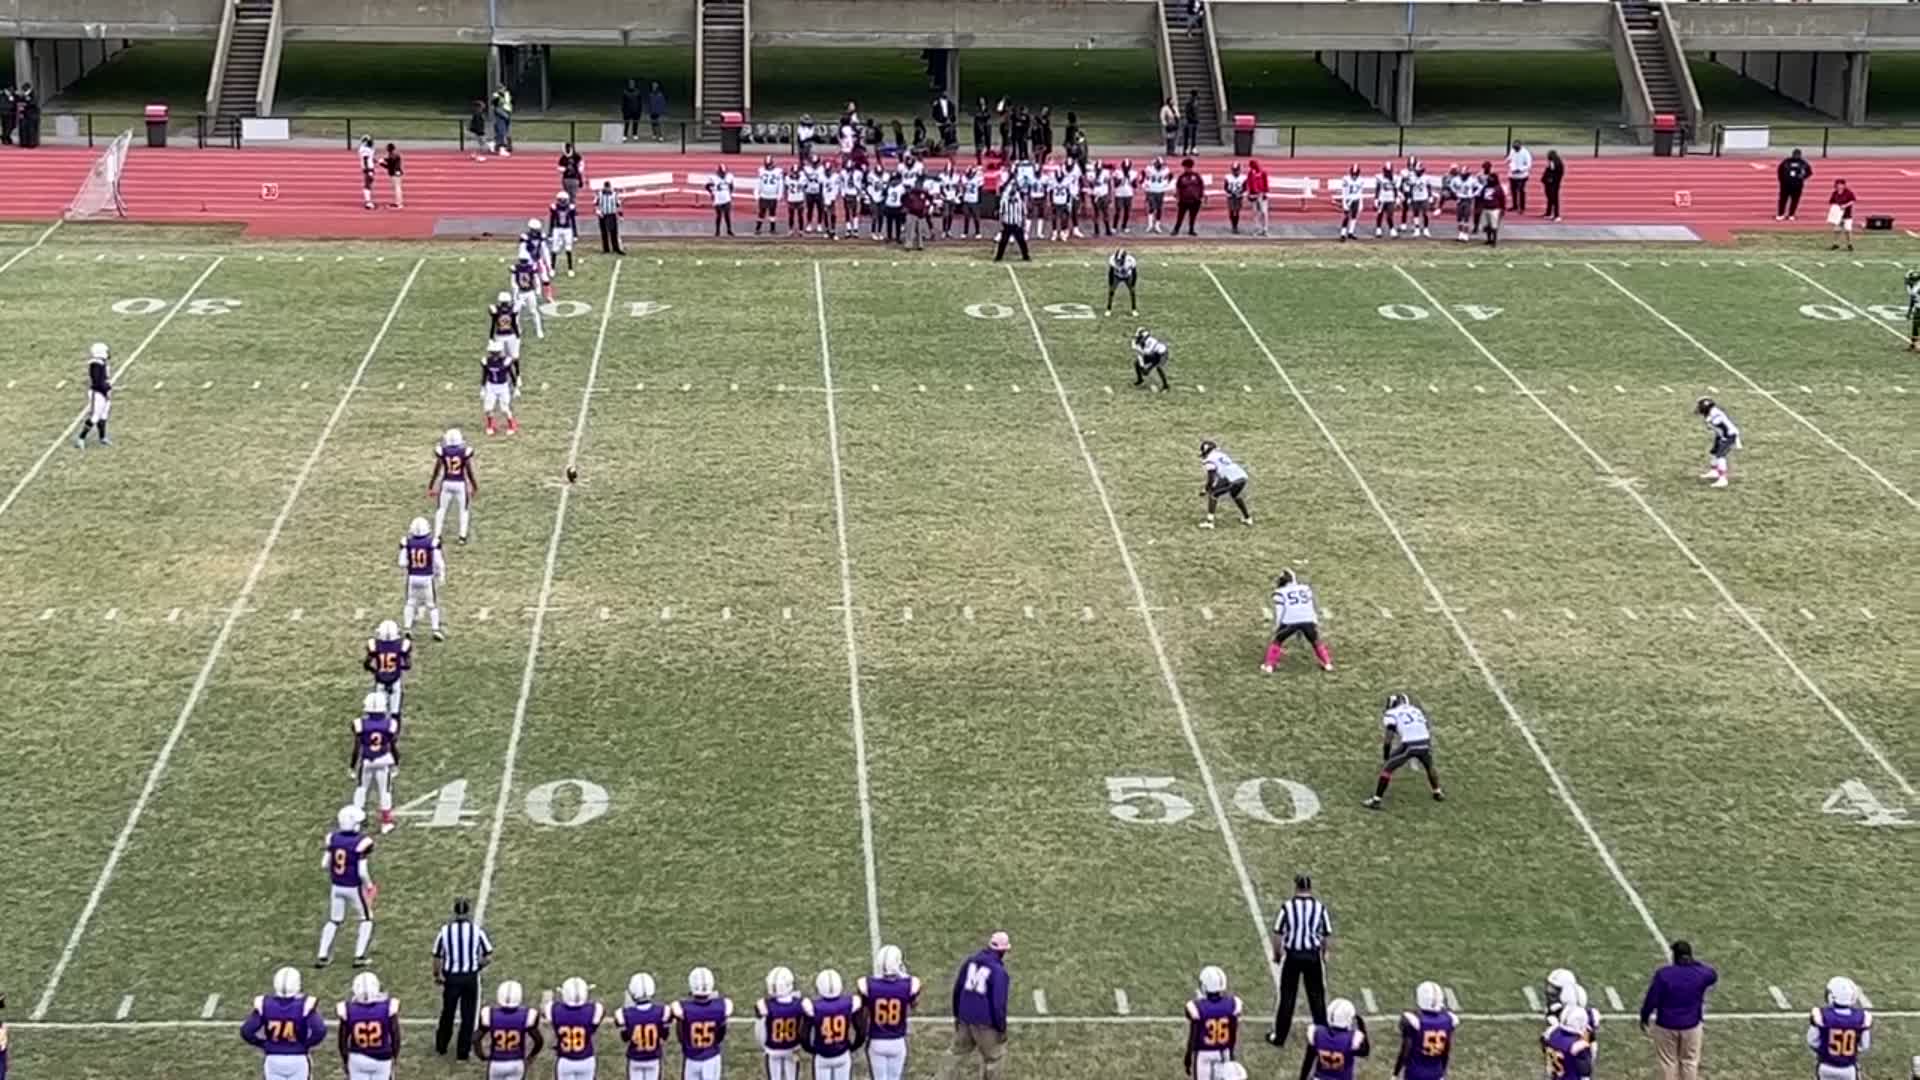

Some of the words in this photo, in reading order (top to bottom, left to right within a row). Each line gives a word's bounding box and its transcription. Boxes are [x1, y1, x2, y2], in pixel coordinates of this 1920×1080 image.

[963, 302, 1097, 320] 50
[1377, 303, 1505, 321] 40
[445, 455, 462, 475] 12
[410, 548, 428, 568] 10
[378, 652, 398, 673] 15
[369, 732, 383, 752] 3
[393, 778, 609, 827] 40
[1104, 776, 1321, 825] 50
[333, 848, 347, 875] 9
[964, 962, 992, 995] M
[874, 999, 902, 1026] 68
[267, 1020, 297, 1043] 74
[353, 1020, 383, 1048] 62
[493, 1029, 520, 1052] 32
[558, 1026, 586, 1053] 38
[631, 1023, 659, 1051] 40
[689, 1021, 716, 1048] 65
[819, 1015, 847, 1044] 49
[1202, 1017, 1230, 1047] 36
[1827, 1029, 1857, 1057] 50
